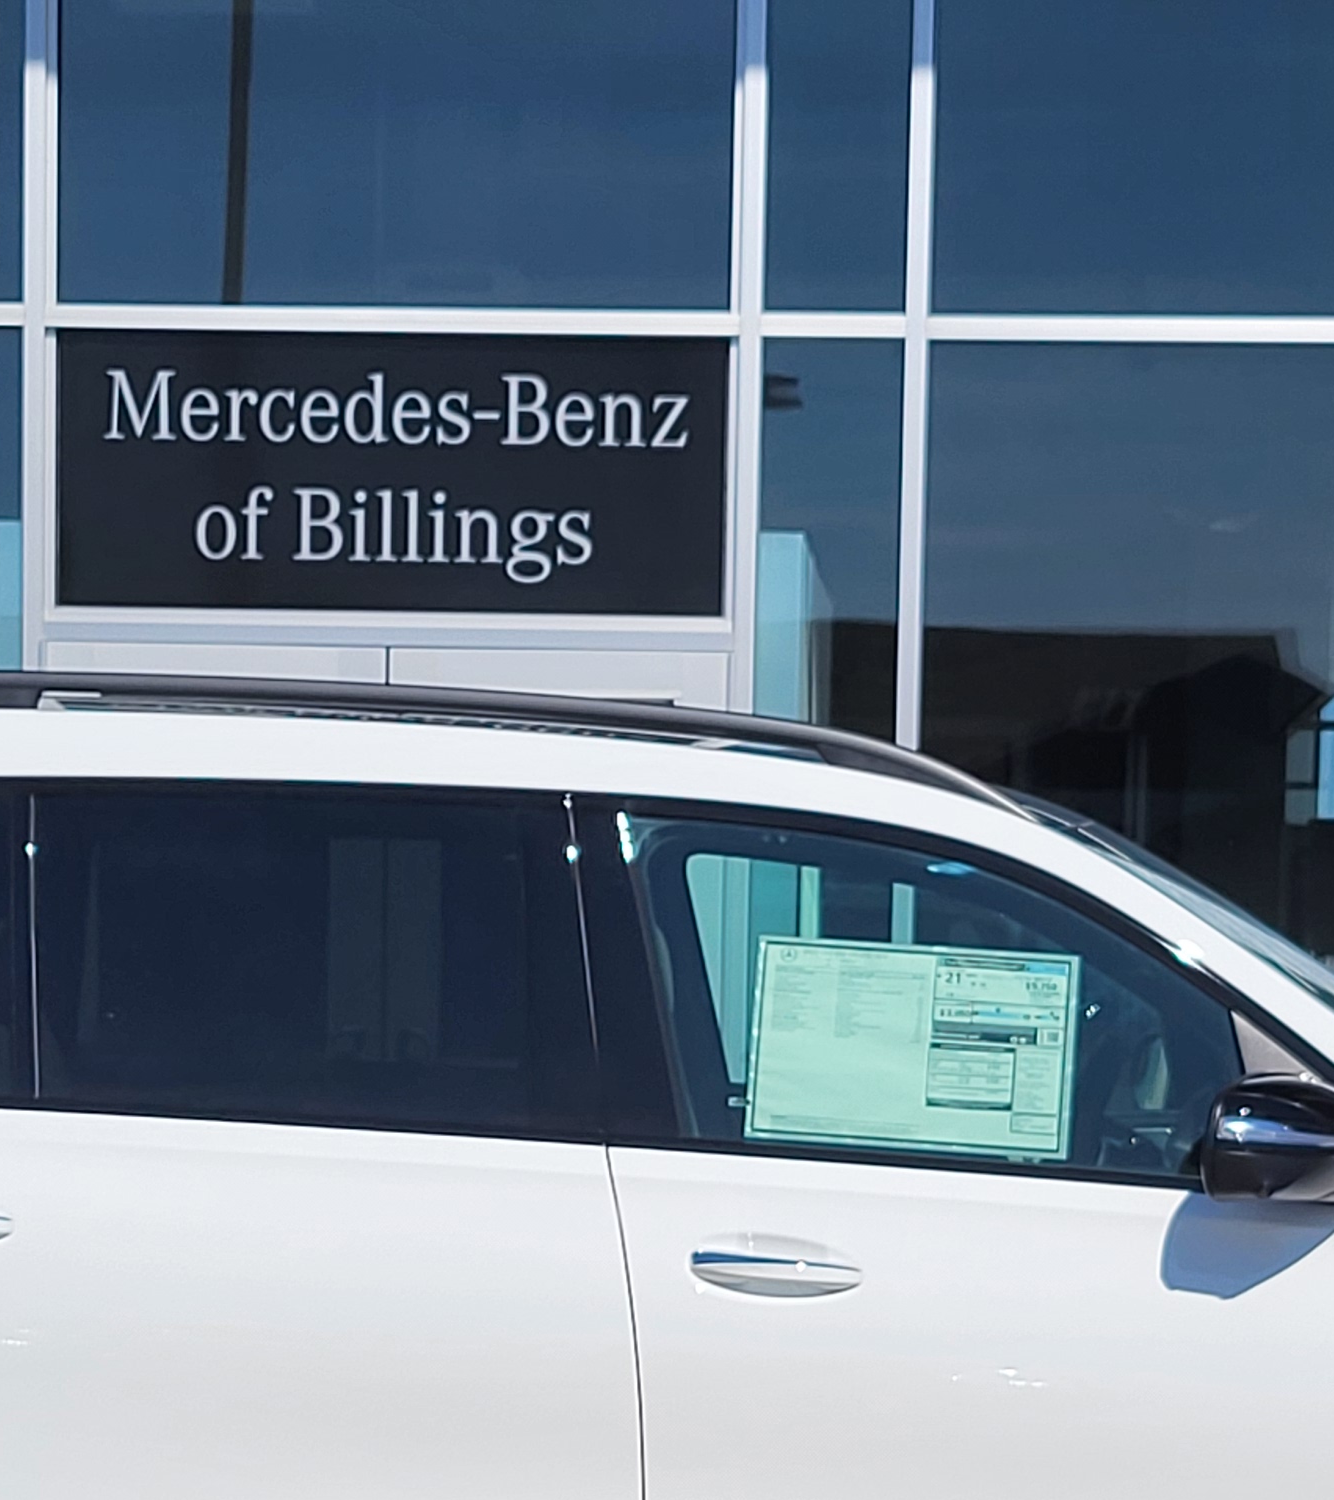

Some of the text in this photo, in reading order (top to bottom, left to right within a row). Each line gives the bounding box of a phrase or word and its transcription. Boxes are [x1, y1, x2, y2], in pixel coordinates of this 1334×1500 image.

[104, 369, 688, 447] Mercedes-Benz
[196, 487, 592, 583] of Billings
